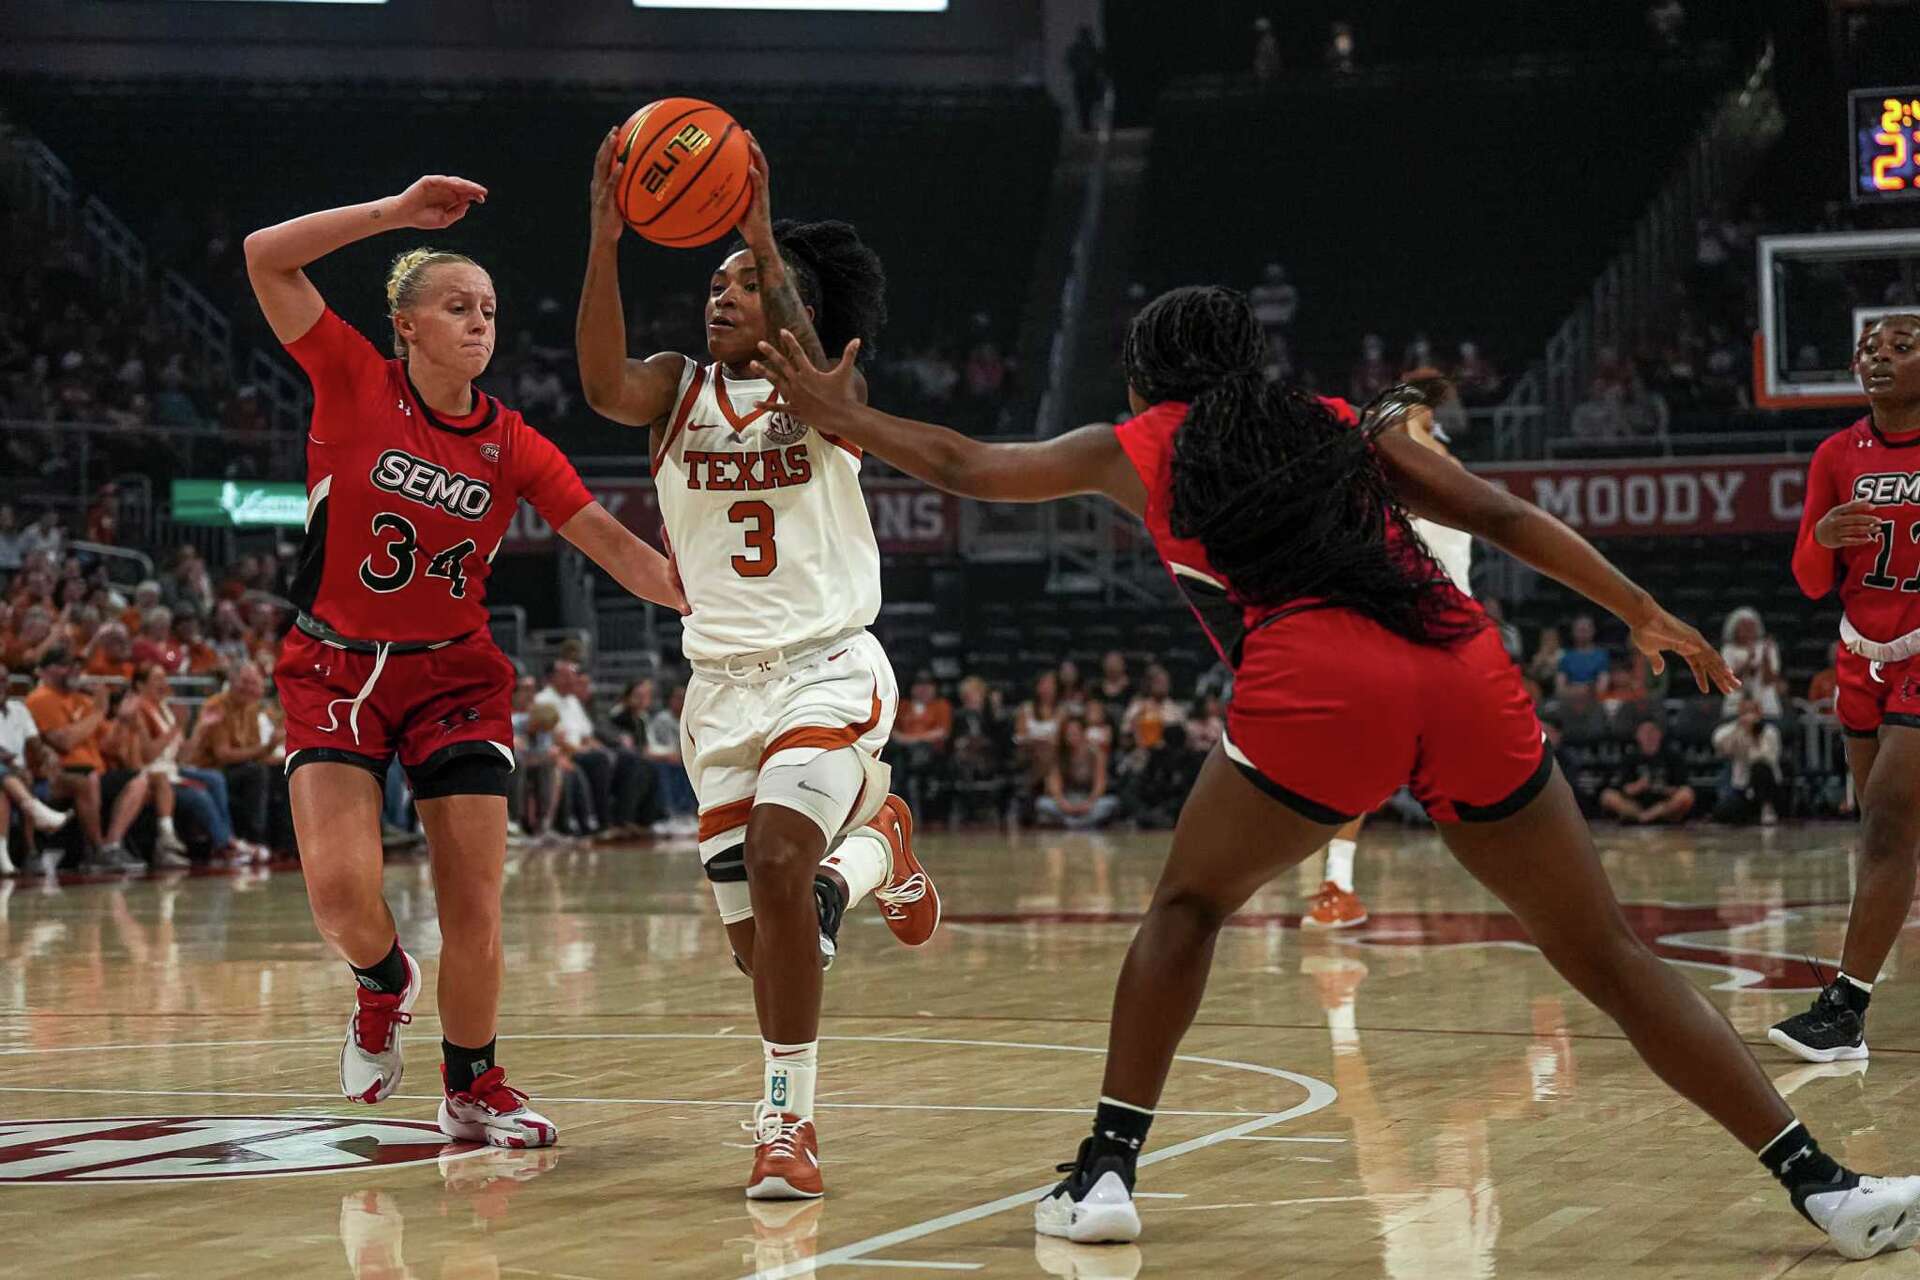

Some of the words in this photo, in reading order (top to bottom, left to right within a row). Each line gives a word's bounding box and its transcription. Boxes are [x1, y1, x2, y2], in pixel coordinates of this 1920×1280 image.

[640, 122, 712, 194] ELITE
[372, 450, 492, 519] SEMO
[684, 444, 812, 490] TEXAS
[1532, 471, 1745, 527] MOODY
[1853, 471, 1920, 506] SEM
[359, 511, 477, 599] 34
[728, 500, 777, 577] 3
